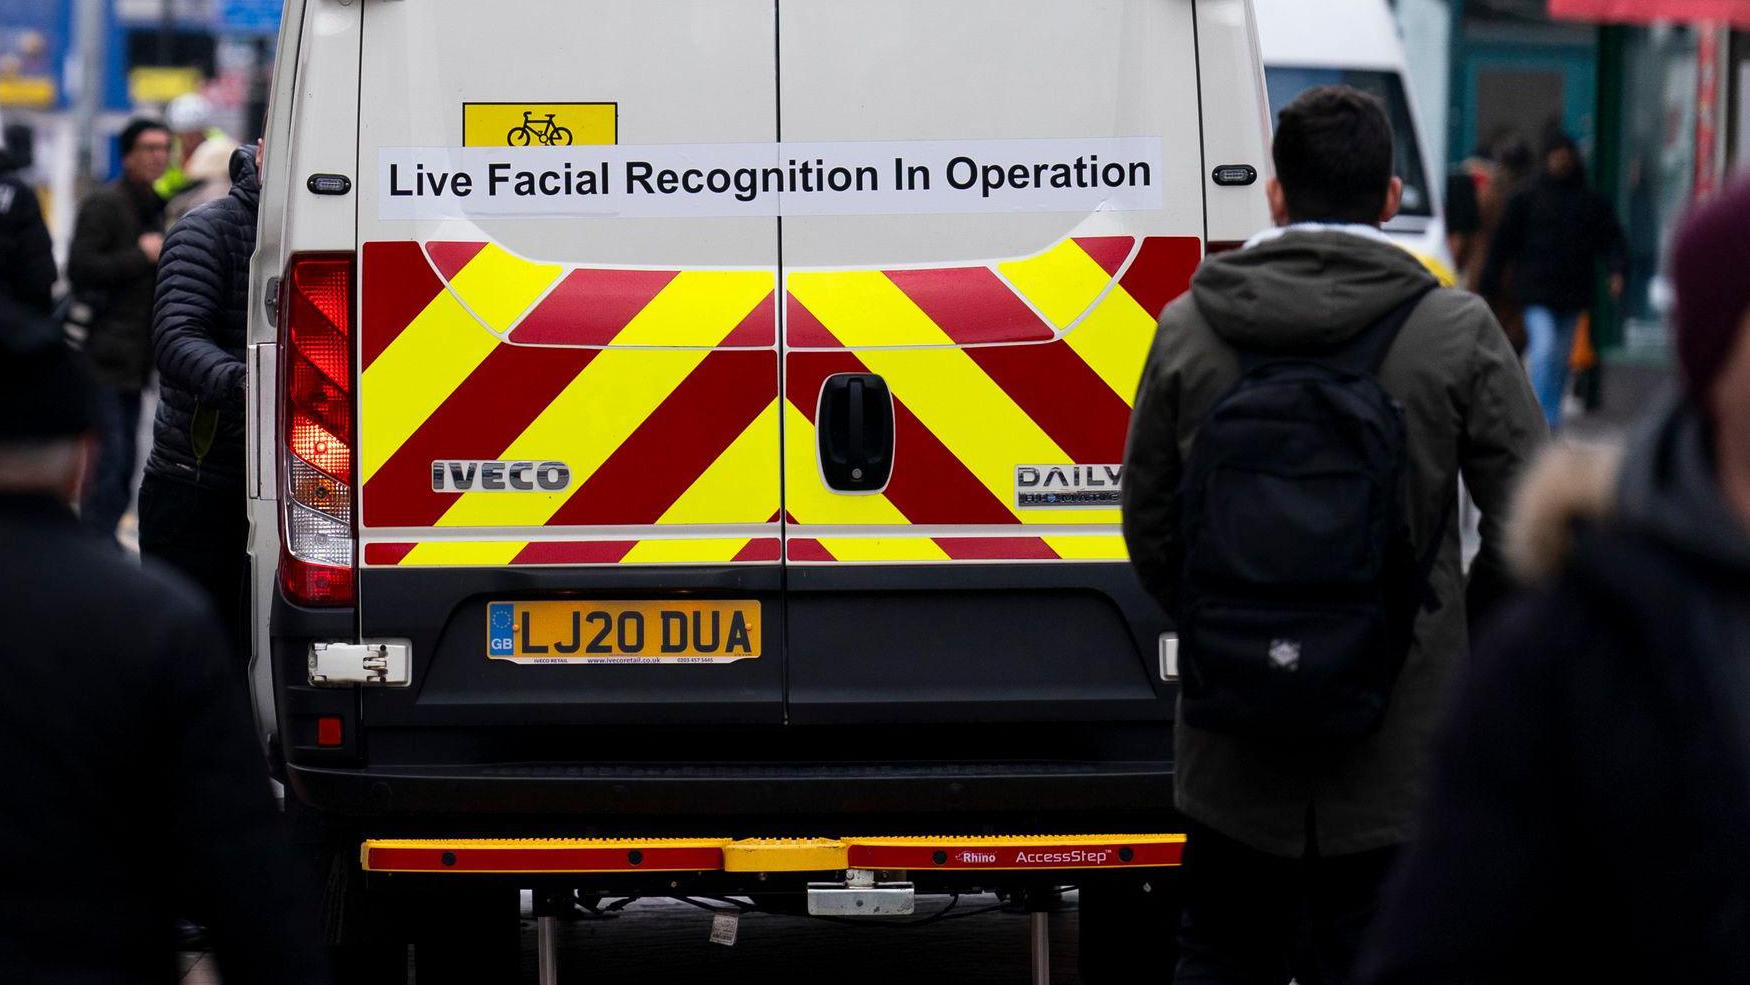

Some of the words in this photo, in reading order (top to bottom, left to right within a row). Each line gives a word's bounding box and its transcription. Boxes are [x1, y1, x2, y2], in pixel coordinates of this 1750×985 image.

[390, 163, 472, 197] Live
[488, 162, 609, 197] Facial
[625, 158, 879, 202] Recognition
[895, 157, 931, 191] In
[947, 154, 1151, 197] Operation
[432, 462, 570, 490] IVECO
[1018, 466, 1123, 487] DAILY
[522, 611, 644, 653] LJ20
[661, 610, 752, 653] DUA
[491, 638, 512, 650] GB
[963, 852, 996, 863] Rhino
